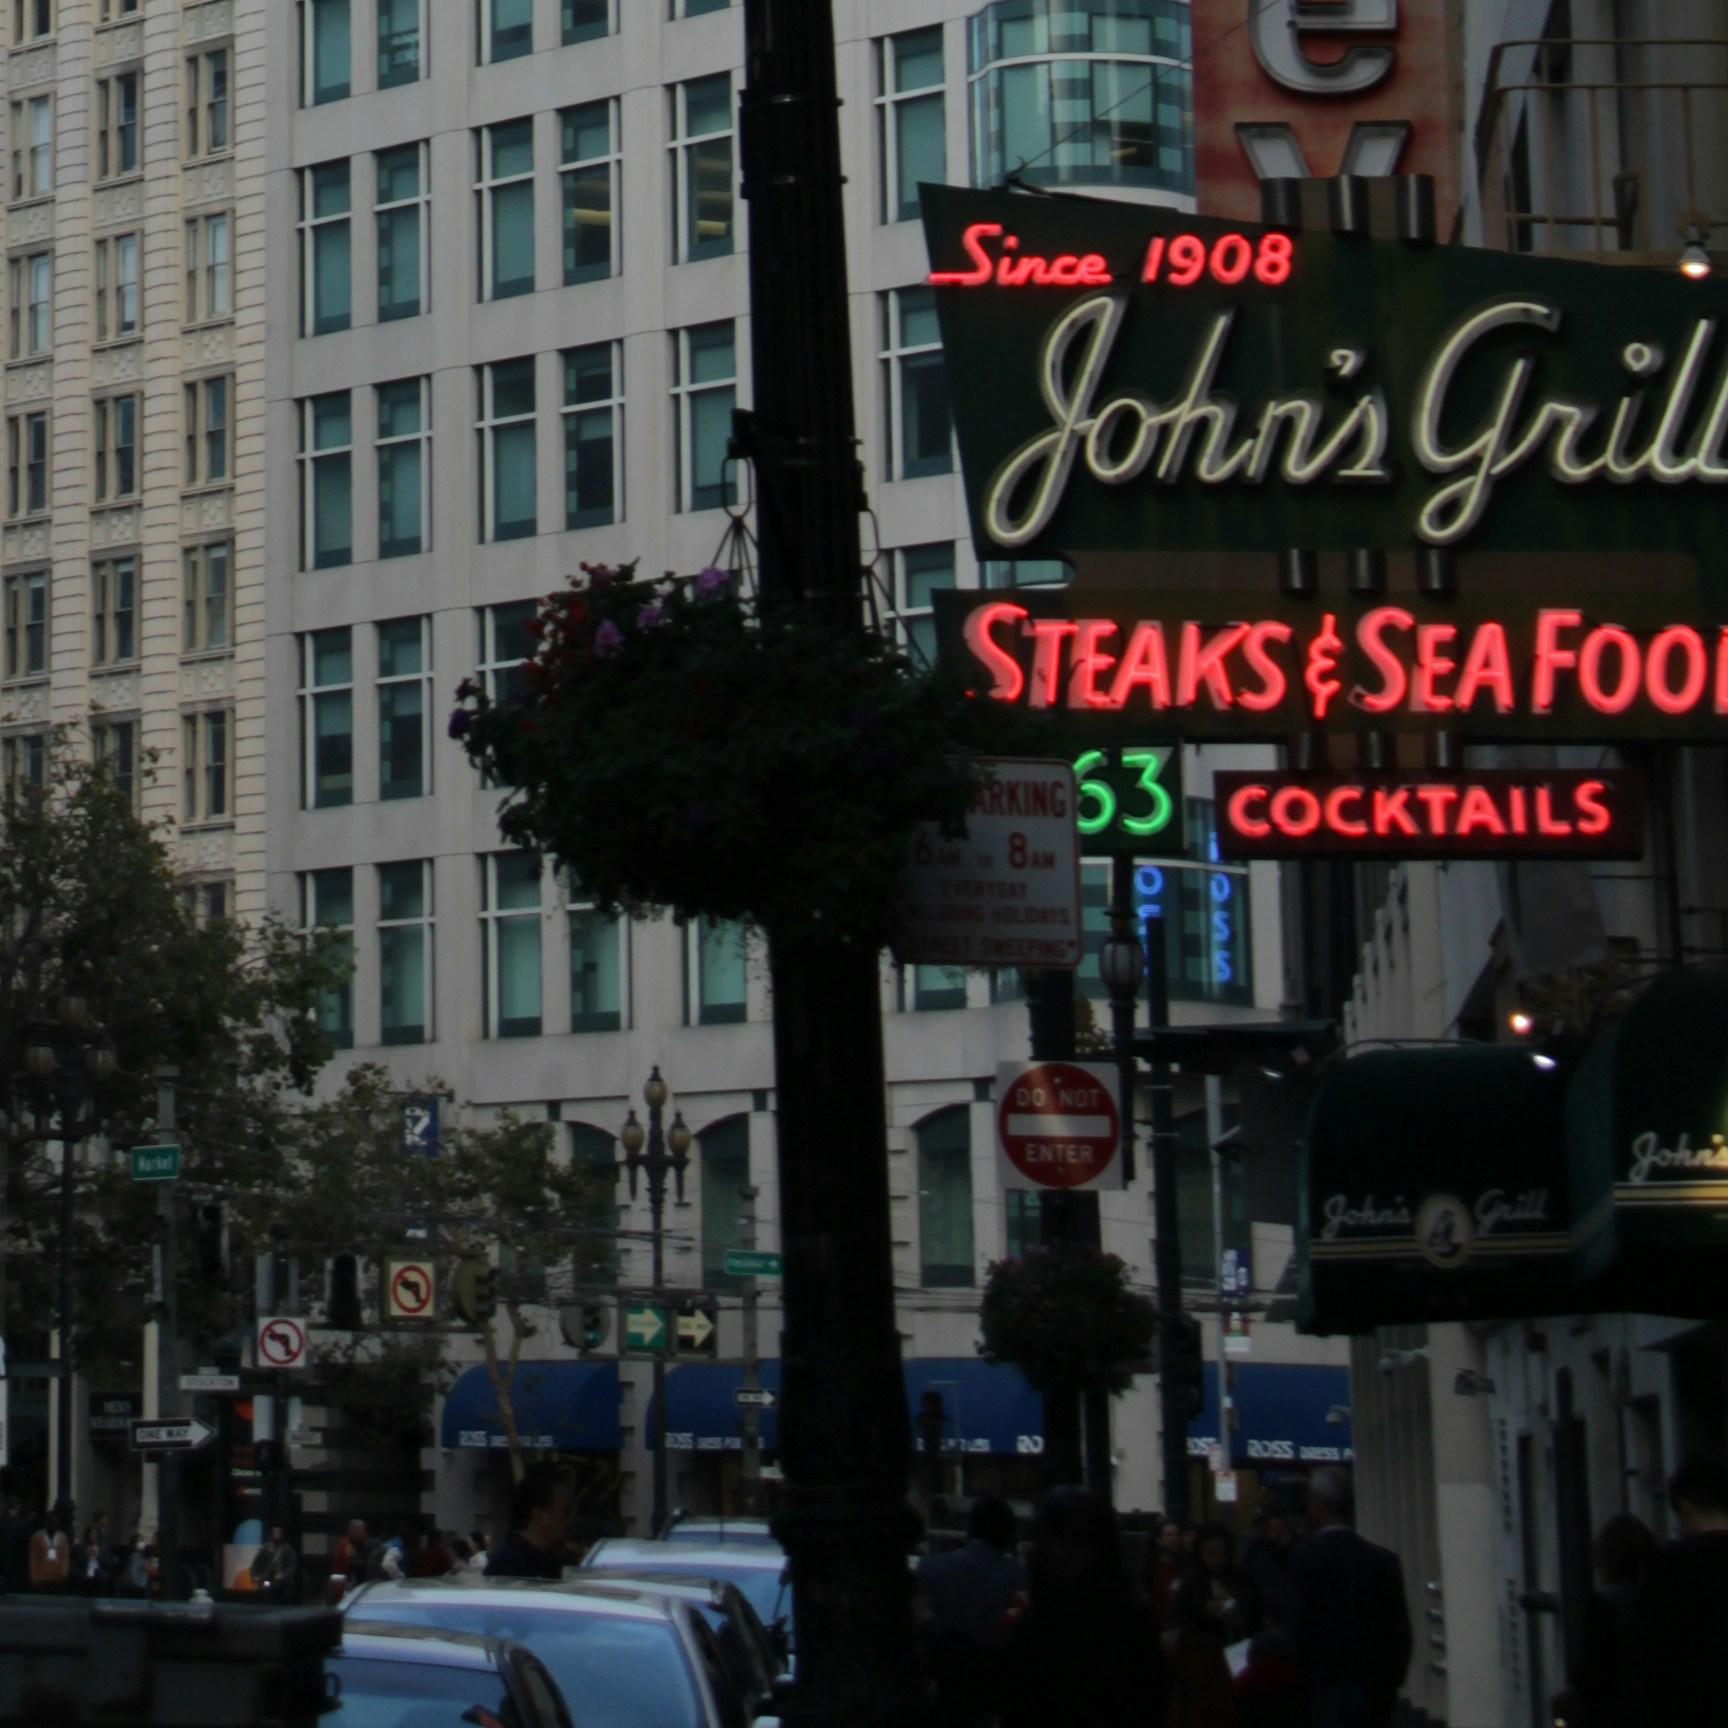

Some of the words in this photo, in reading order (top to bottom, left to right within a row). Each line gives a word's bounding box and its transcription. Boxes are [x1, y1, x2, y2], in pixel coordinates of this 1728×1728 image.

[927, 223, 1113, 287] Since
[1140, 231, 1294, 287] 1908
[982, 289, 1394, 548] John's
[963, 602, 1294, 712] STEAKS
[1305, 611, 1345, 722] &
[970, 779, 1068, 819] ARKING
[1072, 747, 1173, 836] 63
[1226, 780, 1613, 838] COCKTAILS
[940, 879, 1029, 898] EVERYDAY
[991, 905, 1070, 925] HOLIDAYS
[1015, 1087, 1046, 1108] DO
[1058, 1088, 1101, 1108] NOT
[1025, 1143, 1094, 1164] ENTER
[1628, 1130, 1728, 1184] John's
[1321, 1193, 1412, 1241] John's
[1474, 1187, 1549, 1237] Grill
[138, 1427, 162, 1440] ONE
[166, 1426, 189, 1440] WAY
